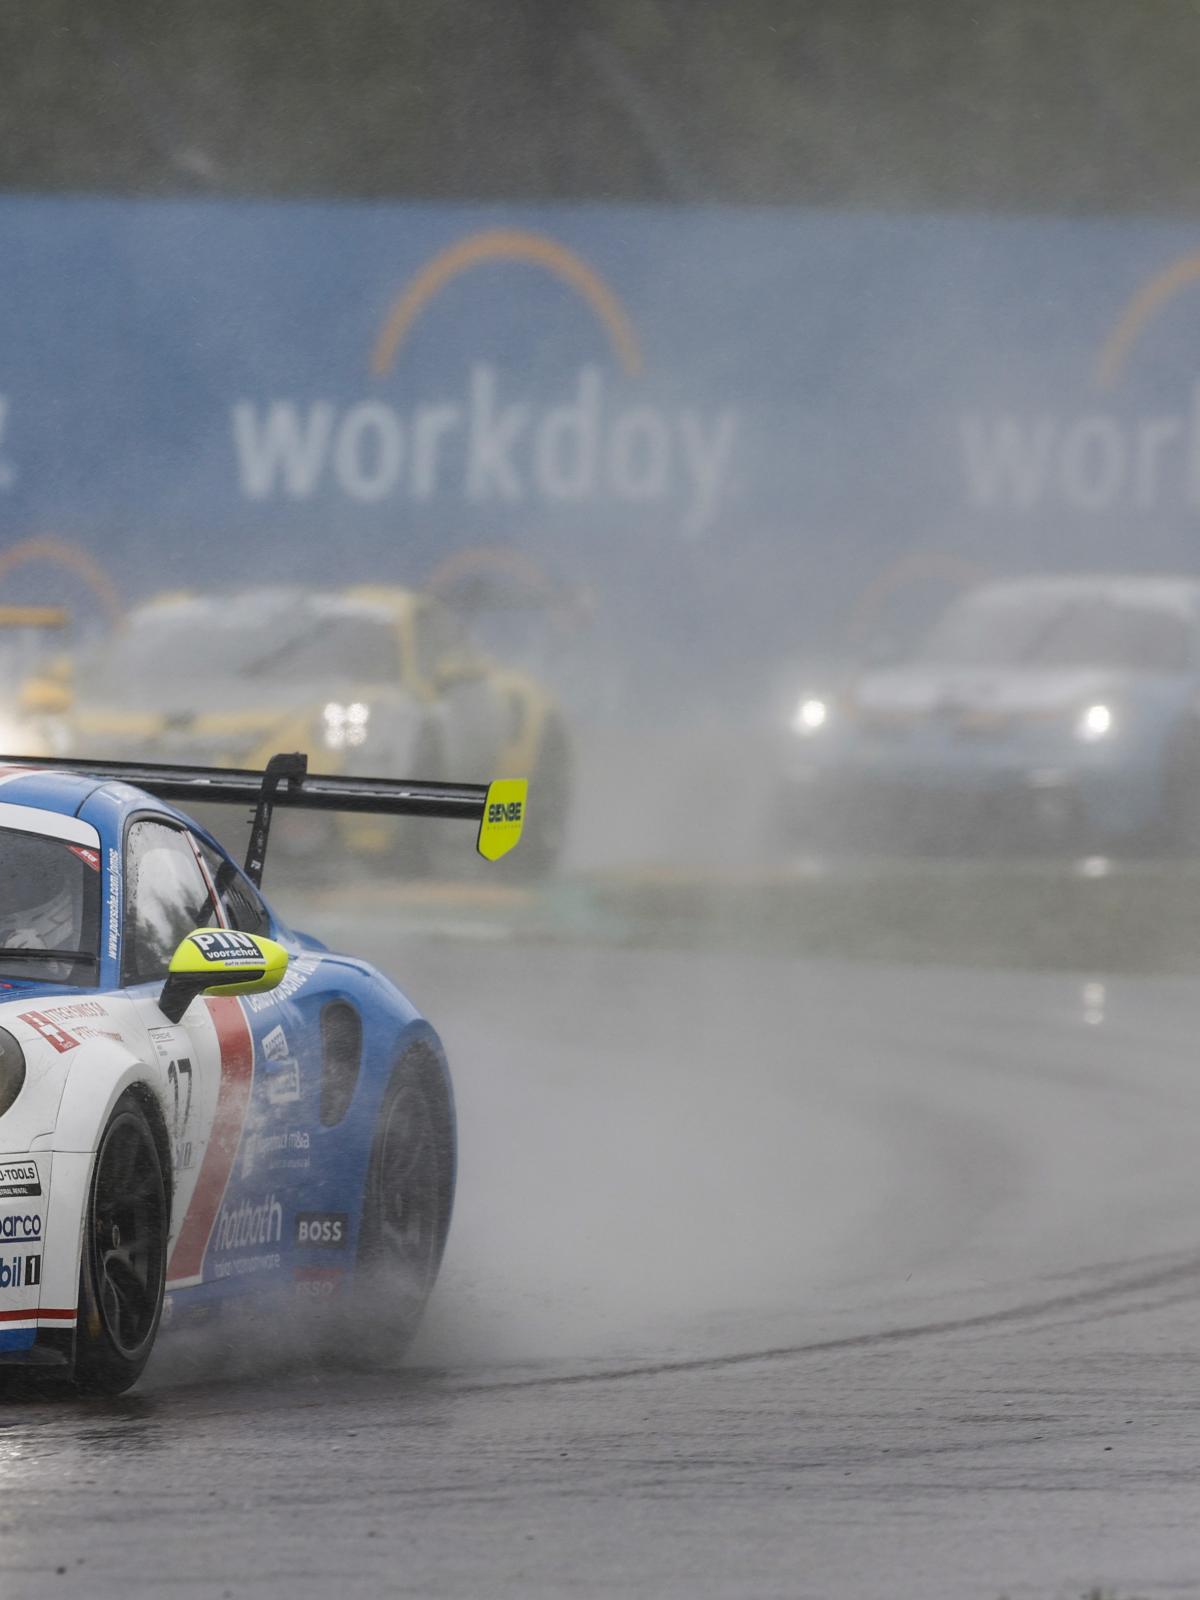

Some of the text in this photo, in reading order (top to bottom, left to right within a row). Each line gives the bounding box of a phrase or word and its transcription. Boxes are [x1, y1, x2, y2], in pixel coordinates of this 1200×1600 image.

[231, 362, 736, 538] workday
[958, 383, 1200, 510] wor
[192, 932, 253, 951] PIN
[206, 948, 259, 959] voorschot
[299, 1220, 342, 1241] BOSS
